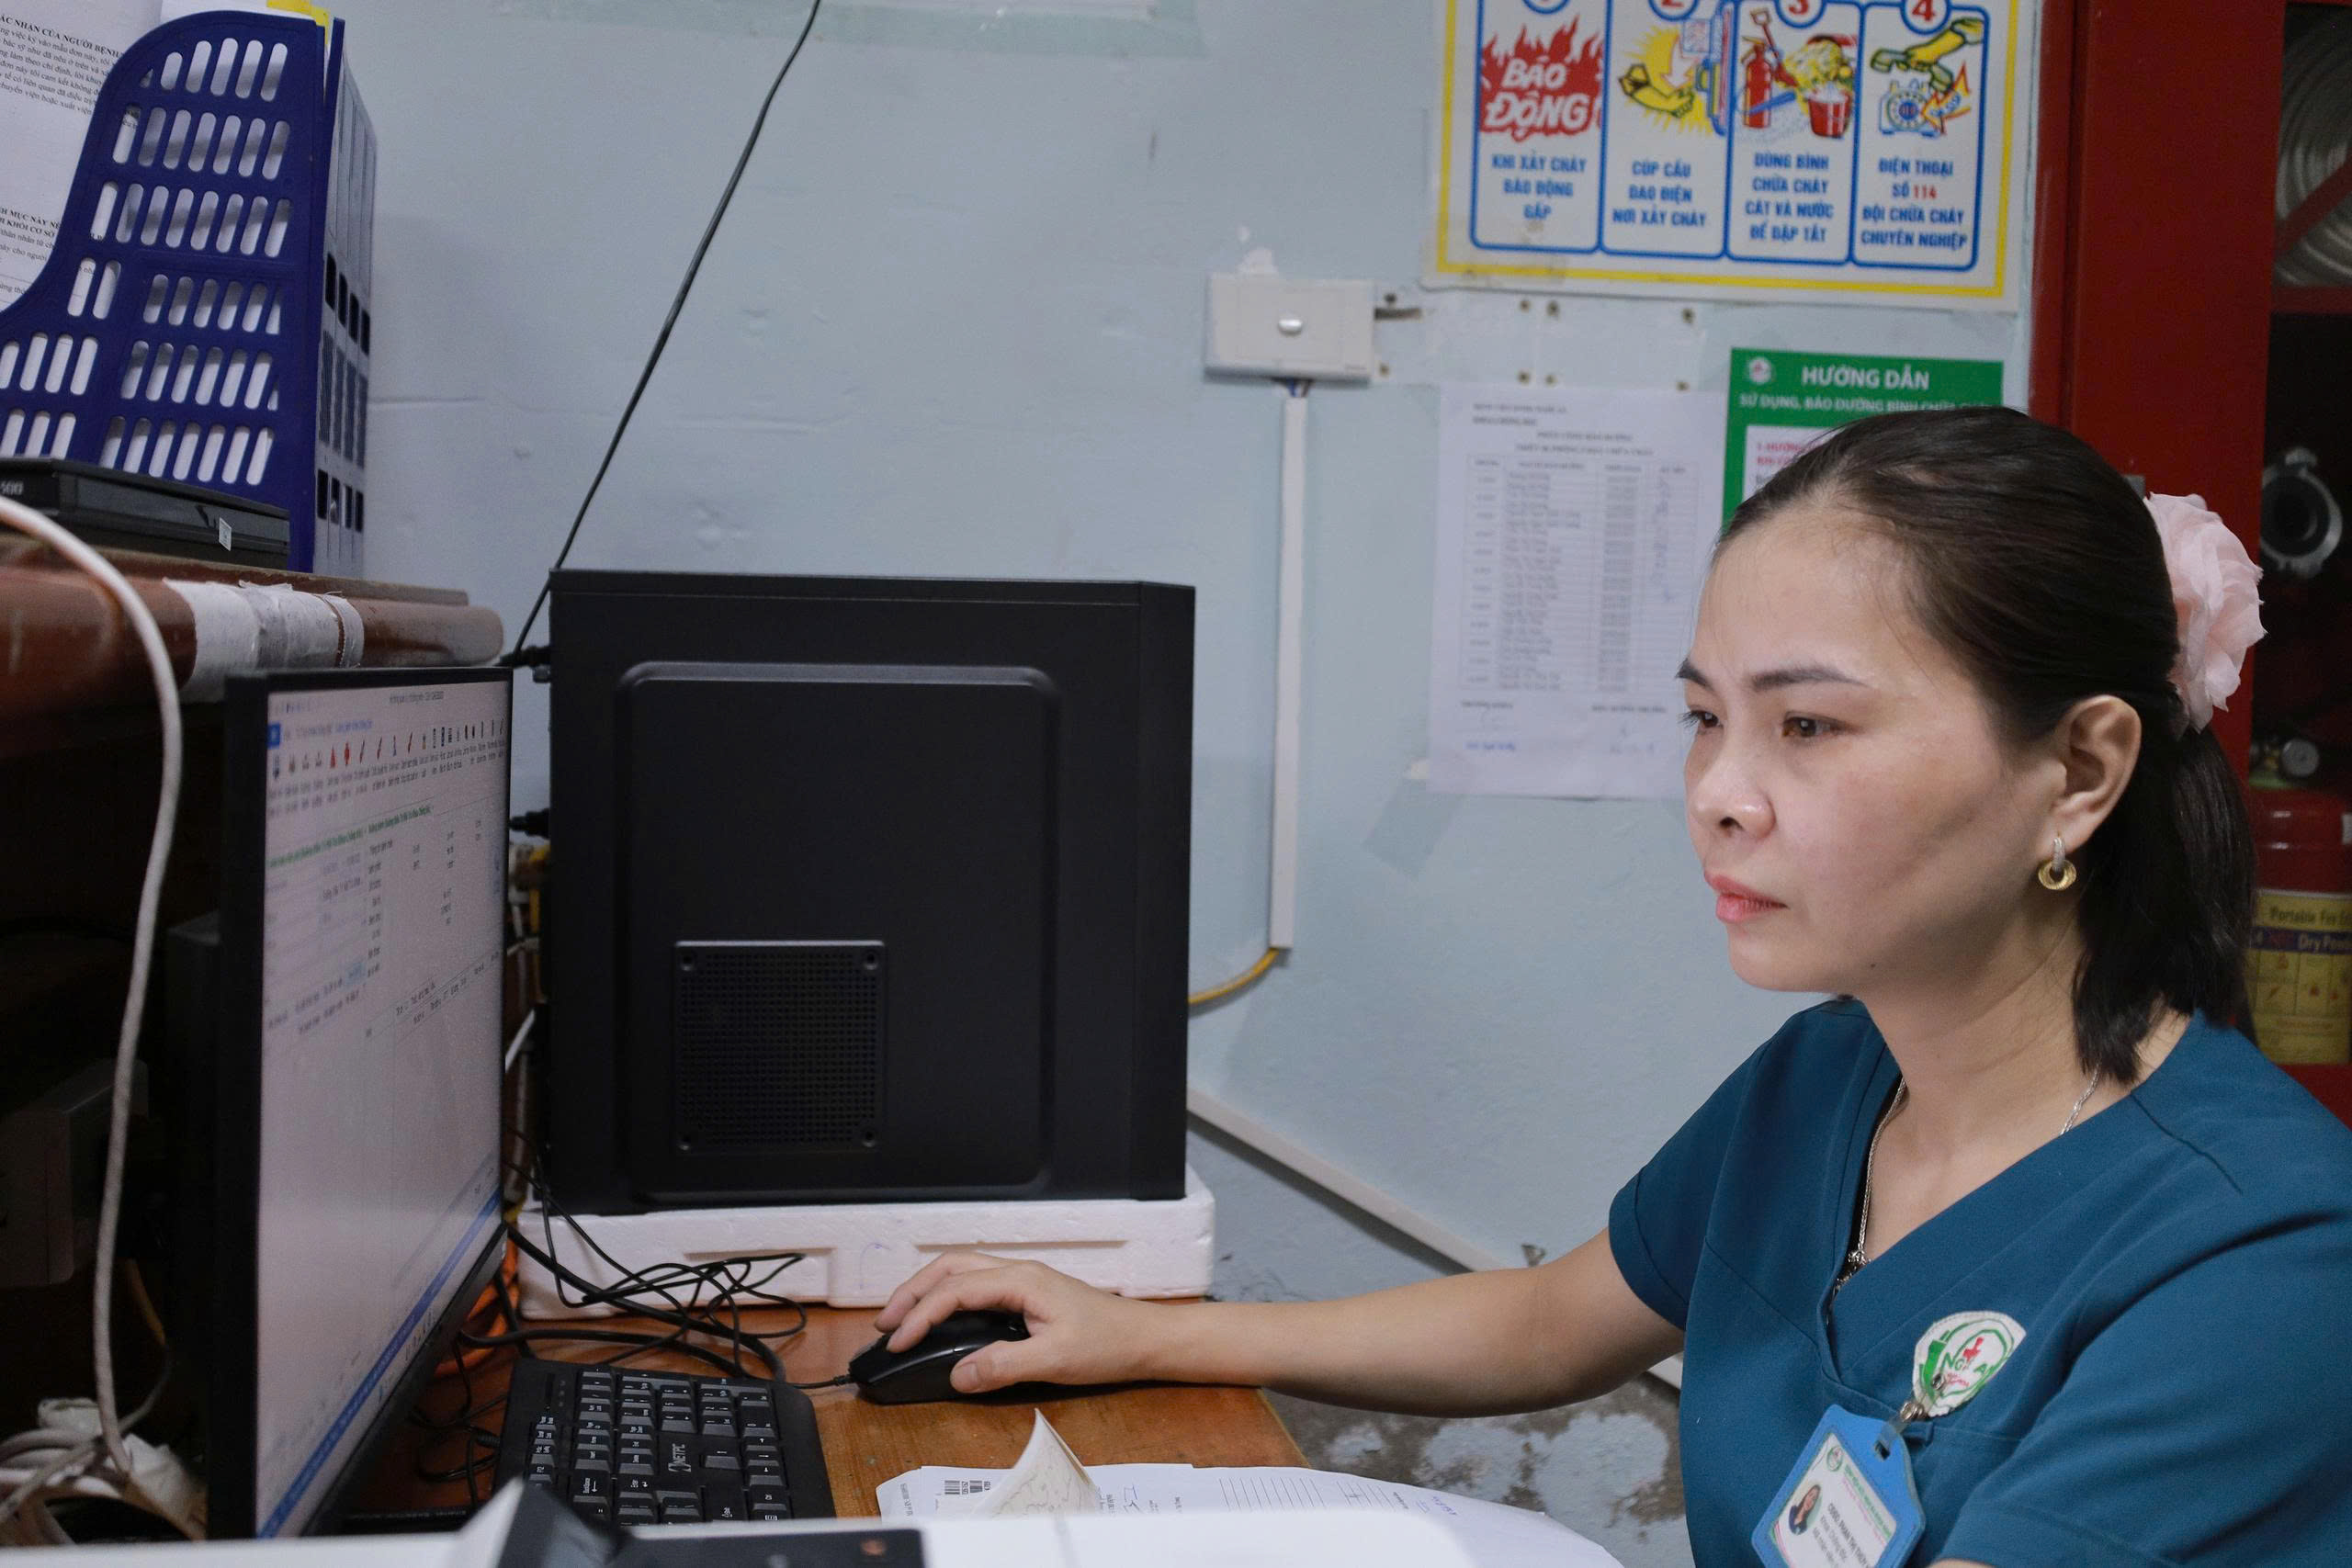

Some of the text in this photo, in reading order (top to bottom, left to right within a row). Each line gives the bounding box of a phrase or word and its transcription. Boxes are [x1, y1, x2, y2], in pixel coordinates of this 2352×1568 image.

[1912, 0, 1936, 21] 4
[1501, 56, 1566, 88] BÁO
[1486, 91, 1589, 135] ĐỘNG
[1492, 150, 1587, 173] KHI XẢY CHÁY
[1632, 158, 1658, 175] CÚP
[1754, 152, 1829, 171] DÙNG BÌNH
[1878, 156, 1953, 179] ĐIỆN THOẠI
[1504, 177, 1573, 198] BÁO ĐỘNG
[1752, 174, 1829, 194] CHỮA CHÁY
[1892, 180, 1937, 199] SỐ 114
[1629, 185, 1692, 205] DAO ĐIỆN
[1612, 204, 1706, 227] NƠI XẢY CHÁY
[1746, 197, 1834, 219] CÁT VÀ NƯỚC
[1862, 204, 1964, 225] ĐỘI CHỮA CHÁY
[1860, 228, 1968, 251] CHUYÊN NGHIỆP
[1801, 360, 1930, 391] HƯỚNG DẪN
